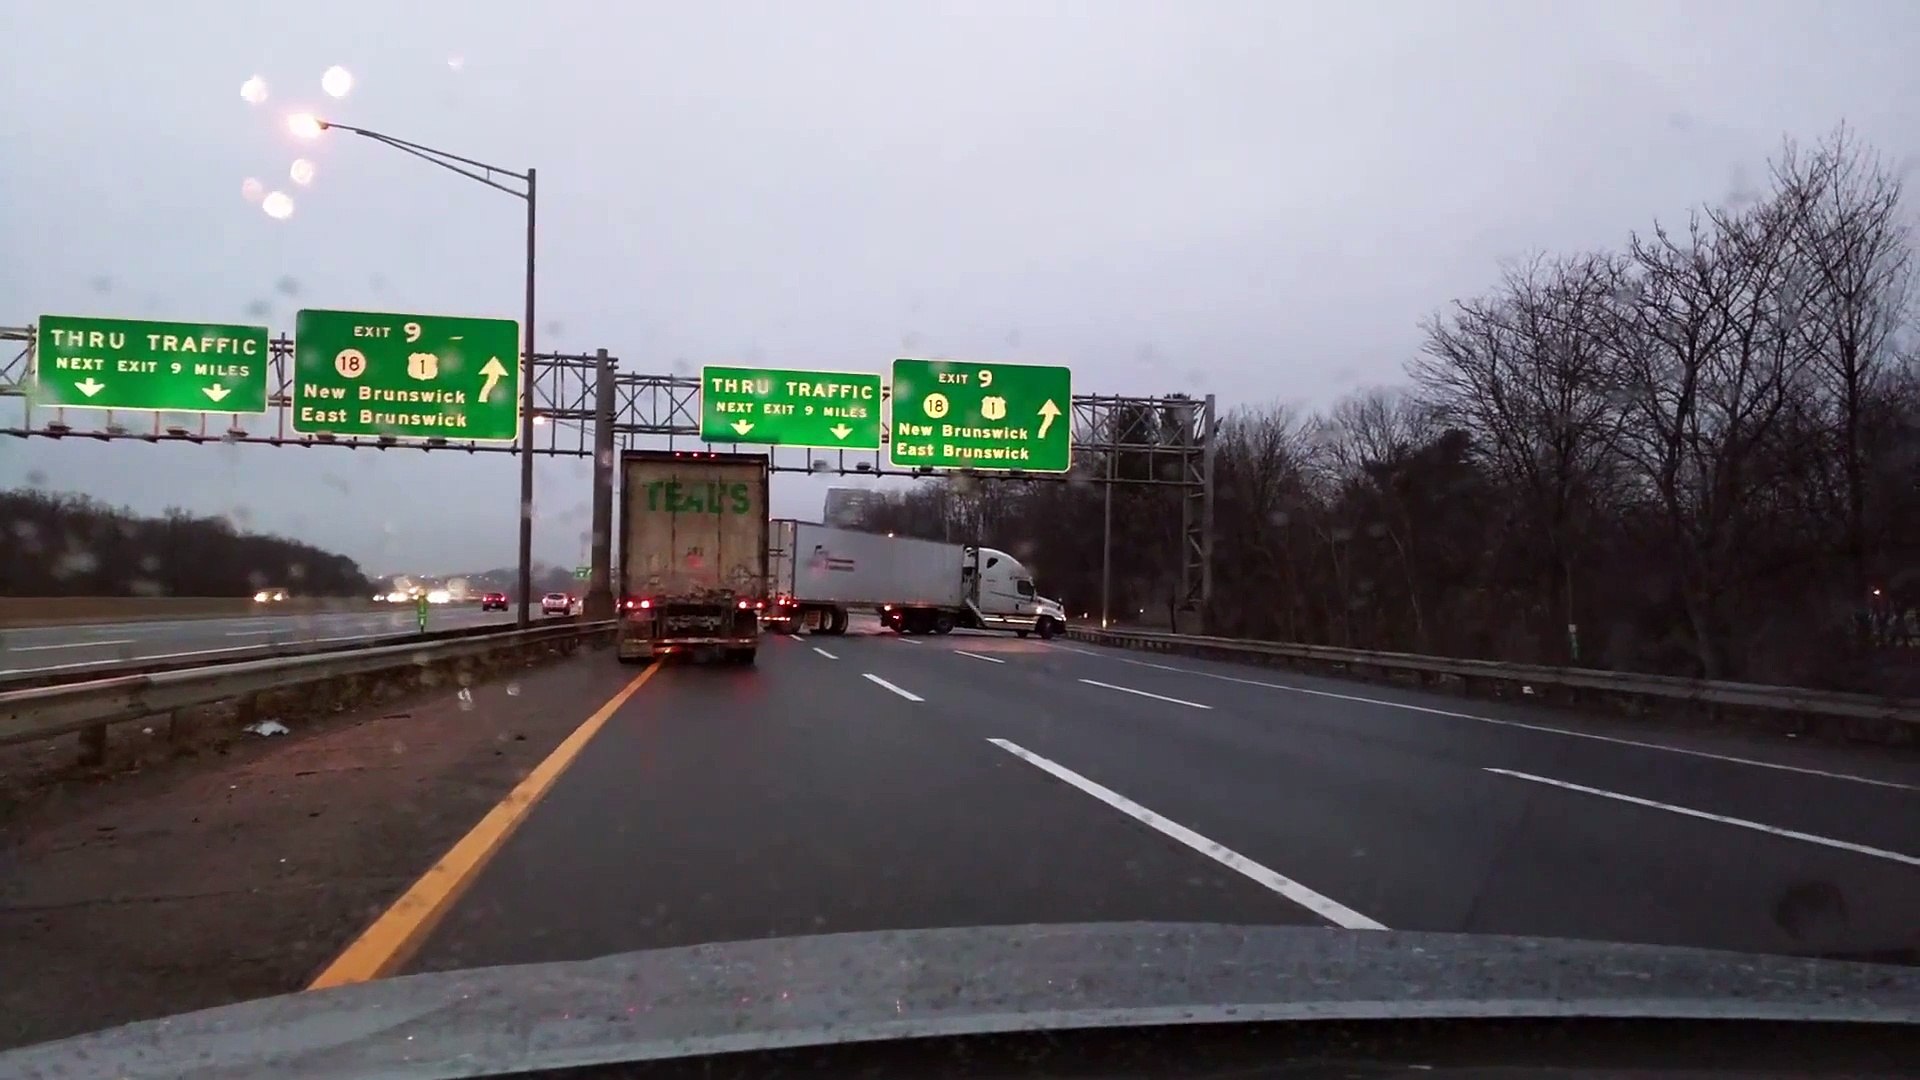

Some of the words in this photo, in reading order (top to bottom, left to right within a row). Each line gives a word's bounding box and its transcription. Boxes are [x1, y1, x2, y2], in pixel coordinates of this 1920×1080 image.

[354, 326, 391, 337] EXIT
[403, 322, 421, 342] 9
[51, 329, 125, 349] THRU
[147, 334, 257, 355] TRAFFIC
[56, 357, 104, 371] NEXT
[117, 360, 158, 373] EXIT
[171, 363, 182, 374] 9
[195, 364, 250, 377] MILES
[340, 356, 360, 371] 18
[939, 373, 968, 384] EXIT
[978, 370, 992, 387] 9
[304, 384, 345, 400] New
[359, 386, 466, 404] Brunswick
[712, 378, 769, 395] THRU
[786, 382, 873, 399] TRAFFIC
[716, 402, 754, 413] NEXT
[764, 404, 795, 415] EXIT
[805, 406, 813, 415] 9
[824, 407, 867, 418] MILES
[929, 399, 943, 412] 18
[301, 407, 347, 423] East
[360, 409, 466, 427] Brunswick
[899, 423, 933, 436] New
[942, 425, 1028, 440] Brunswick
[897, 443, 934, 456] East
[943, 445, 1029, 460] Brunswick
